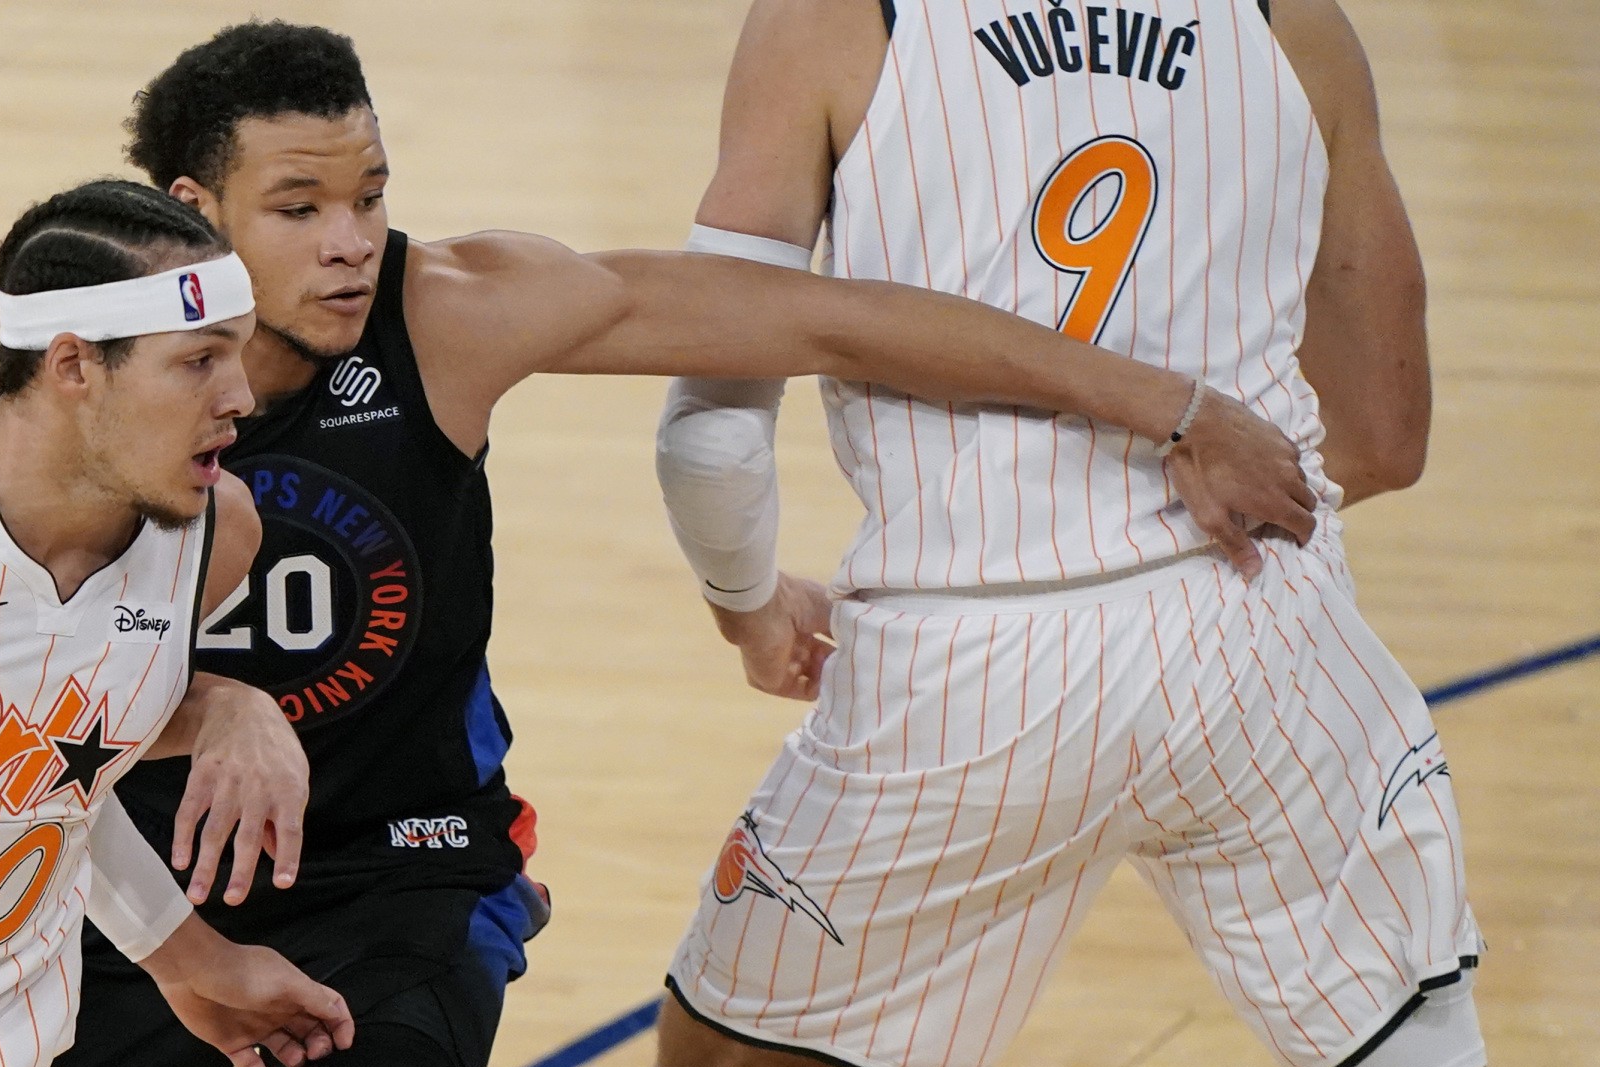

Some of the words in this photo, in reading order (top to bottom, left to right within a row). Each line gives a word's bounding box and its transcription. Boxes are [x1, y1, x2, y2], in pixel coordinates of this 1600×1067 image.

[974, 0, 1200, 90] VUČEVIĆ
[1031, 134, 1158, 345] 9
[320, 406, 400, 429] SQUARESPACE
[311, 488, 395, 557] NEW
[113, 605, 171, 641] Disney
[196, 554, 333, 651] 20
[359, 559, 409, 657] YORK
[279, 660, 375, 722] KNIC
[387, 815, 469, 849] NYC
